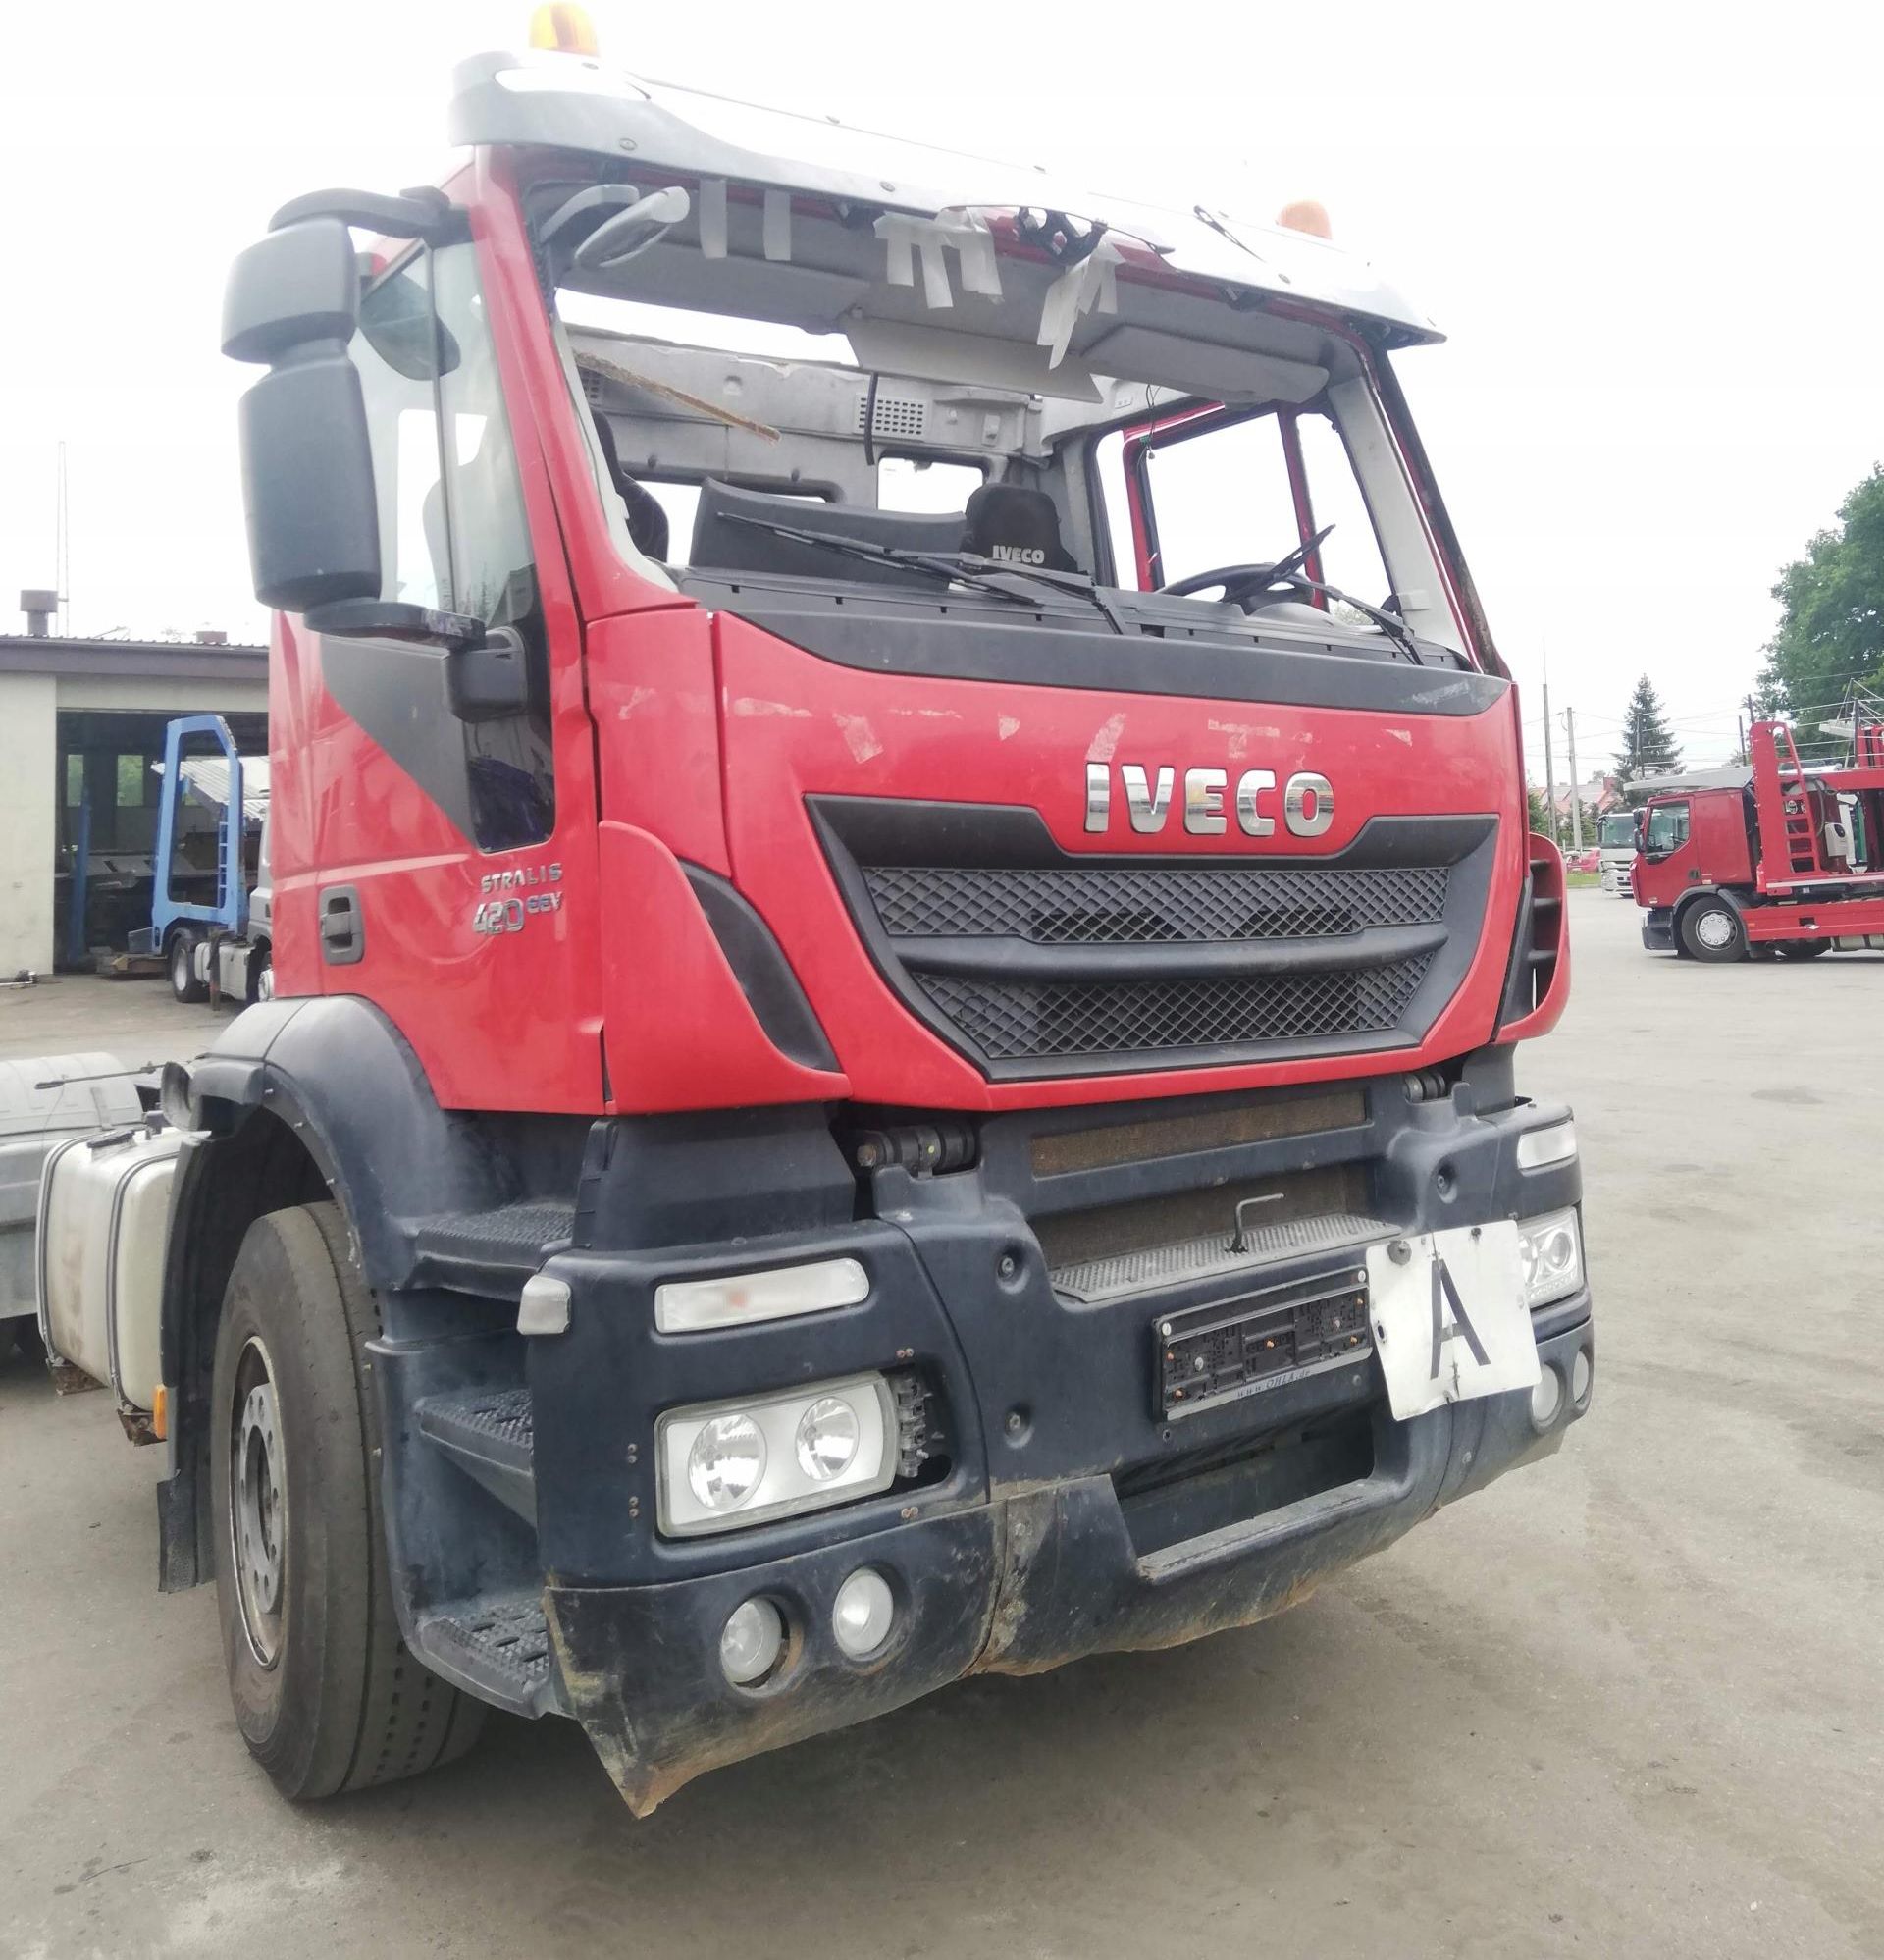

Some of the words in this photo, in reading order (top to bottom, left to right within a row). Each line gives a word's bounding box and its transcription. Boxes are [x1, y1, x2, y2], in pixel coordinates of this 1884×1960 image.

[992, 545, 1045, 564] IVECO
[1084, 763, 1335, 837] IVECO
[481, 863, 563, 894] STRALIS
[473, 898, 524, 934] 420
[1429, 1258, 1492, 1380] A
